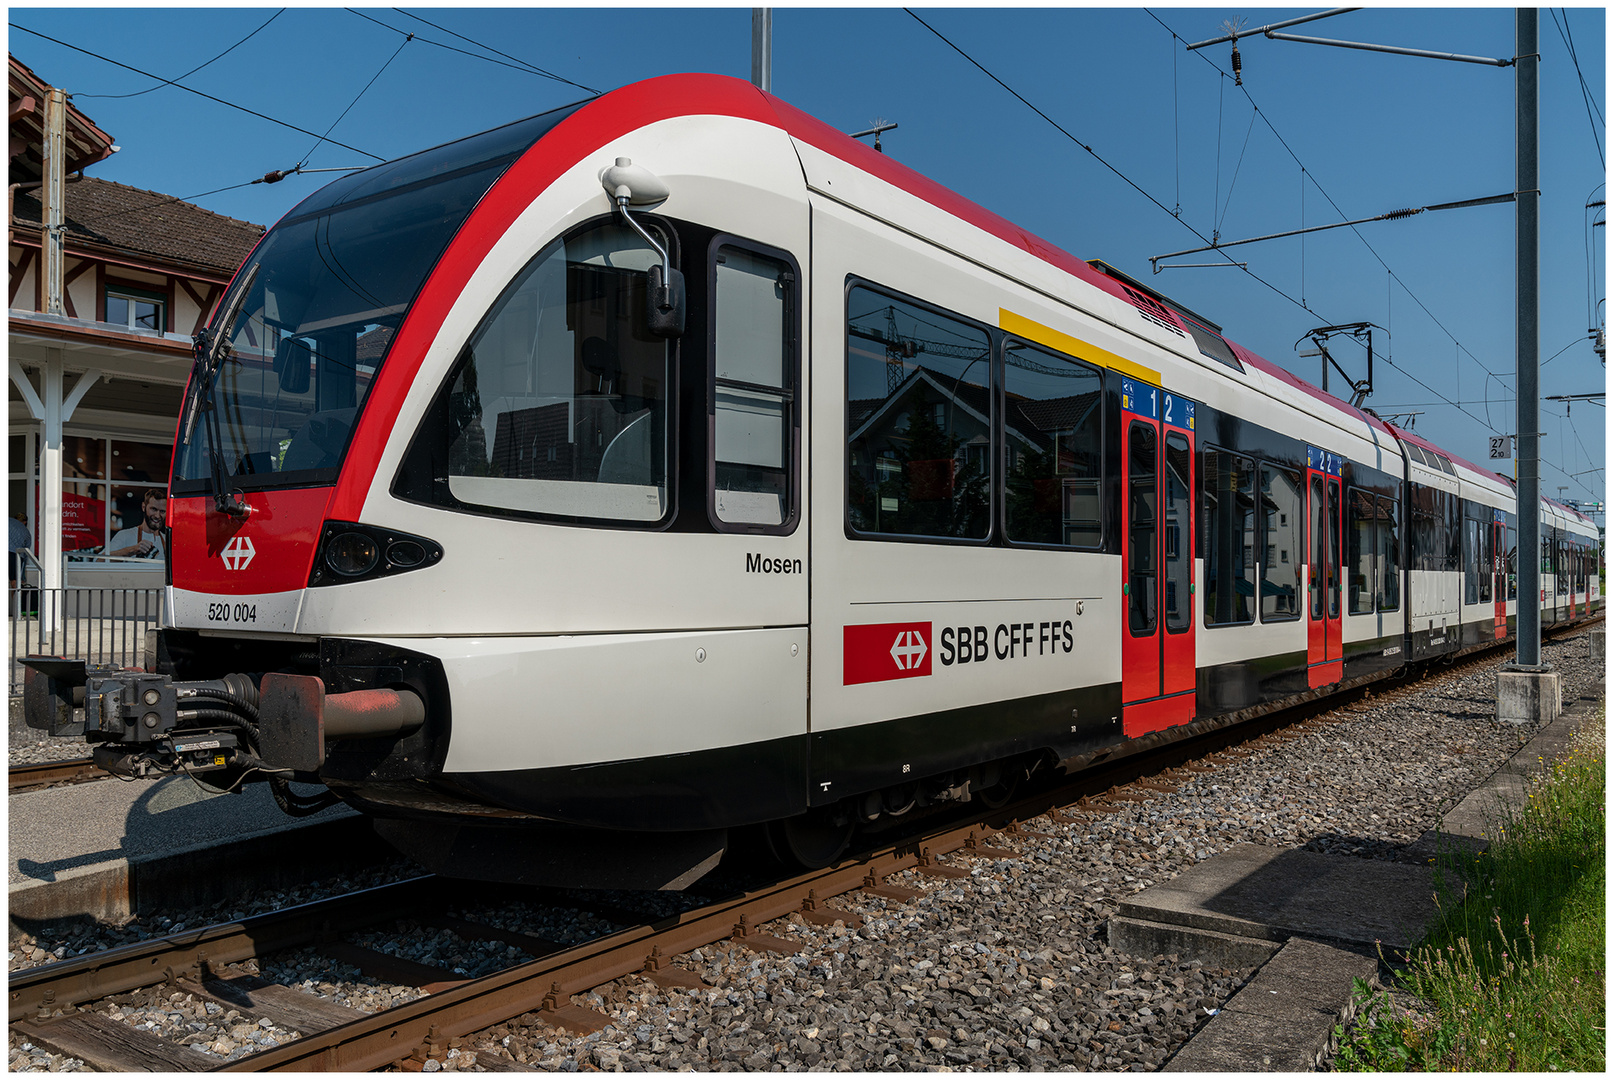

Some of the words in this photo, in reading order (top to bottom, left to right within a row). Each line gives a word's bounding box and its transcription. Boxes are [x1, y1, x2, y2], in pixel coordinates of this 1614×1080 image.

[1150, 389, 1156, 417] 1
[1164, 394, 1173, 423] 2
[1491, 438, 1504, 448] 27
[1319, 450, 1325, 471] 2
[1326, 453, 1332, 473] 2
[746, 552, 802, 574] Mosen
[208, 603, 230, 621] 520
[234, 603, 256, 622] 004
[940, 626, 989, 666] SBB
[994, 622, 1034, 660] CFF
[1039, 620, 1074, 655] FFS
